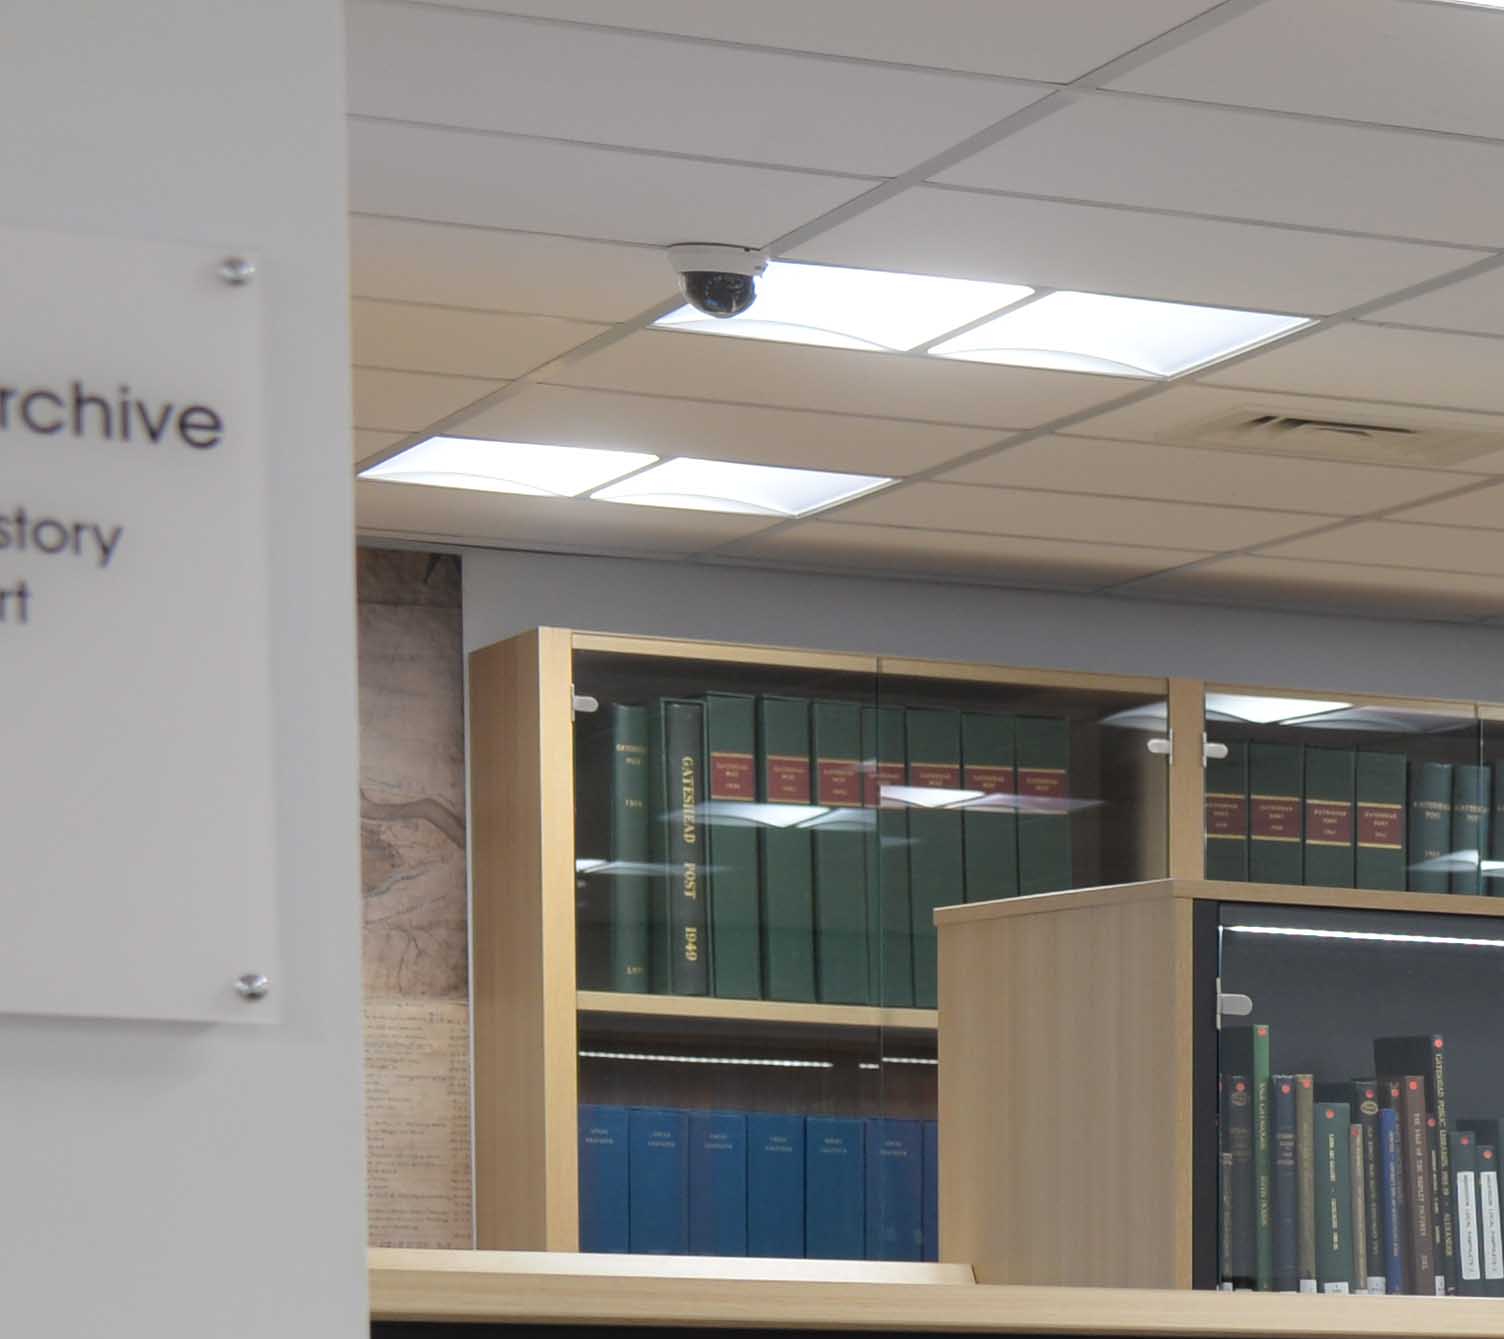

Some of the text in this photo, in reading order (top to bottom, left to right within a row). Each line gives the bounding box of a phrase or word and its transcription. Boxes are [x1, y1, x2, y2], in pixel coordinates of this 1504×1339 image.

[0, 380, 223, 451] rchive
[0, 506, 124, 567] story
[681, 756, 697, 843] GATESHEAD
[683, 862, 697, 899] POST
